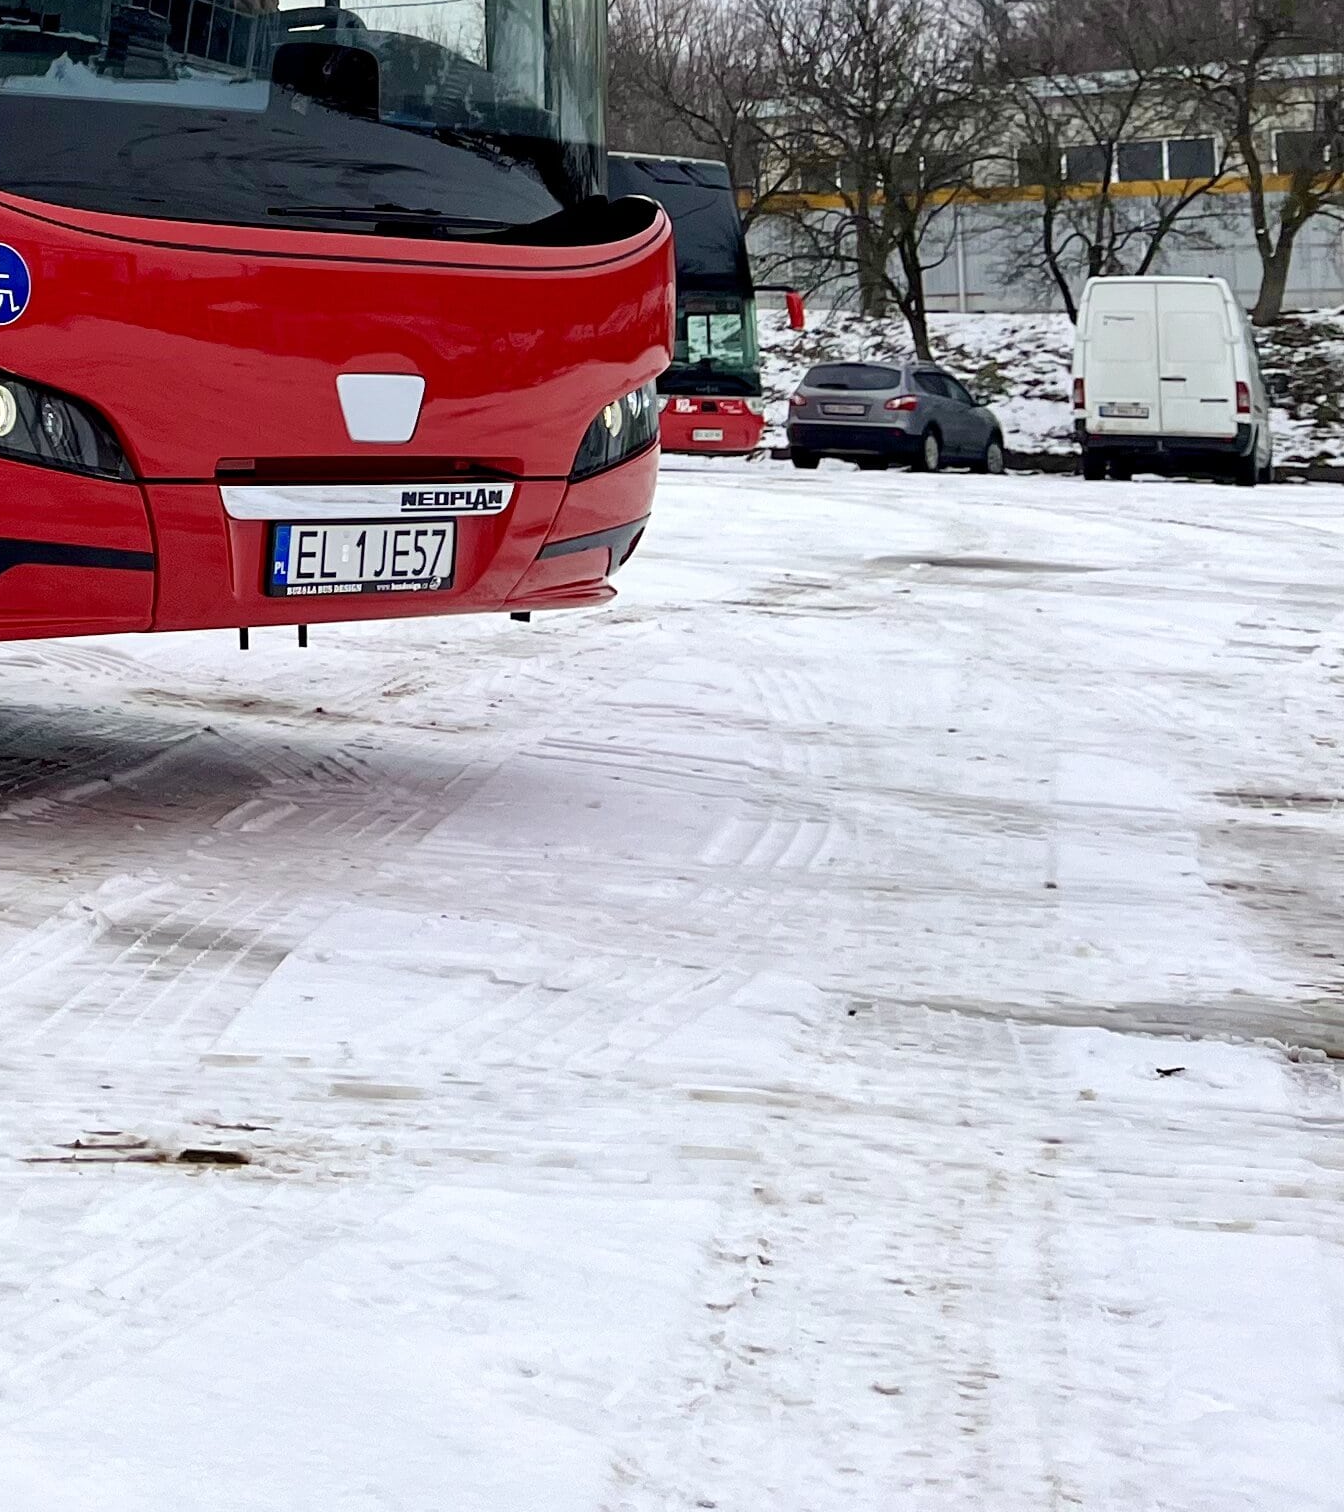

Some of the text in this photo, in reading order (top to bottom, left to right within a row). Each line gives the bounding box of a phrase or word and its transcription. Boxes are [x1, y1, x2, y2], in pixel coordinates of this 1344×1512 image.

[401, 488, 503, 511] NEOPLAN
[296, 528, 448, 580] EL 1JE57
[274, 561, 287, 576] PL
